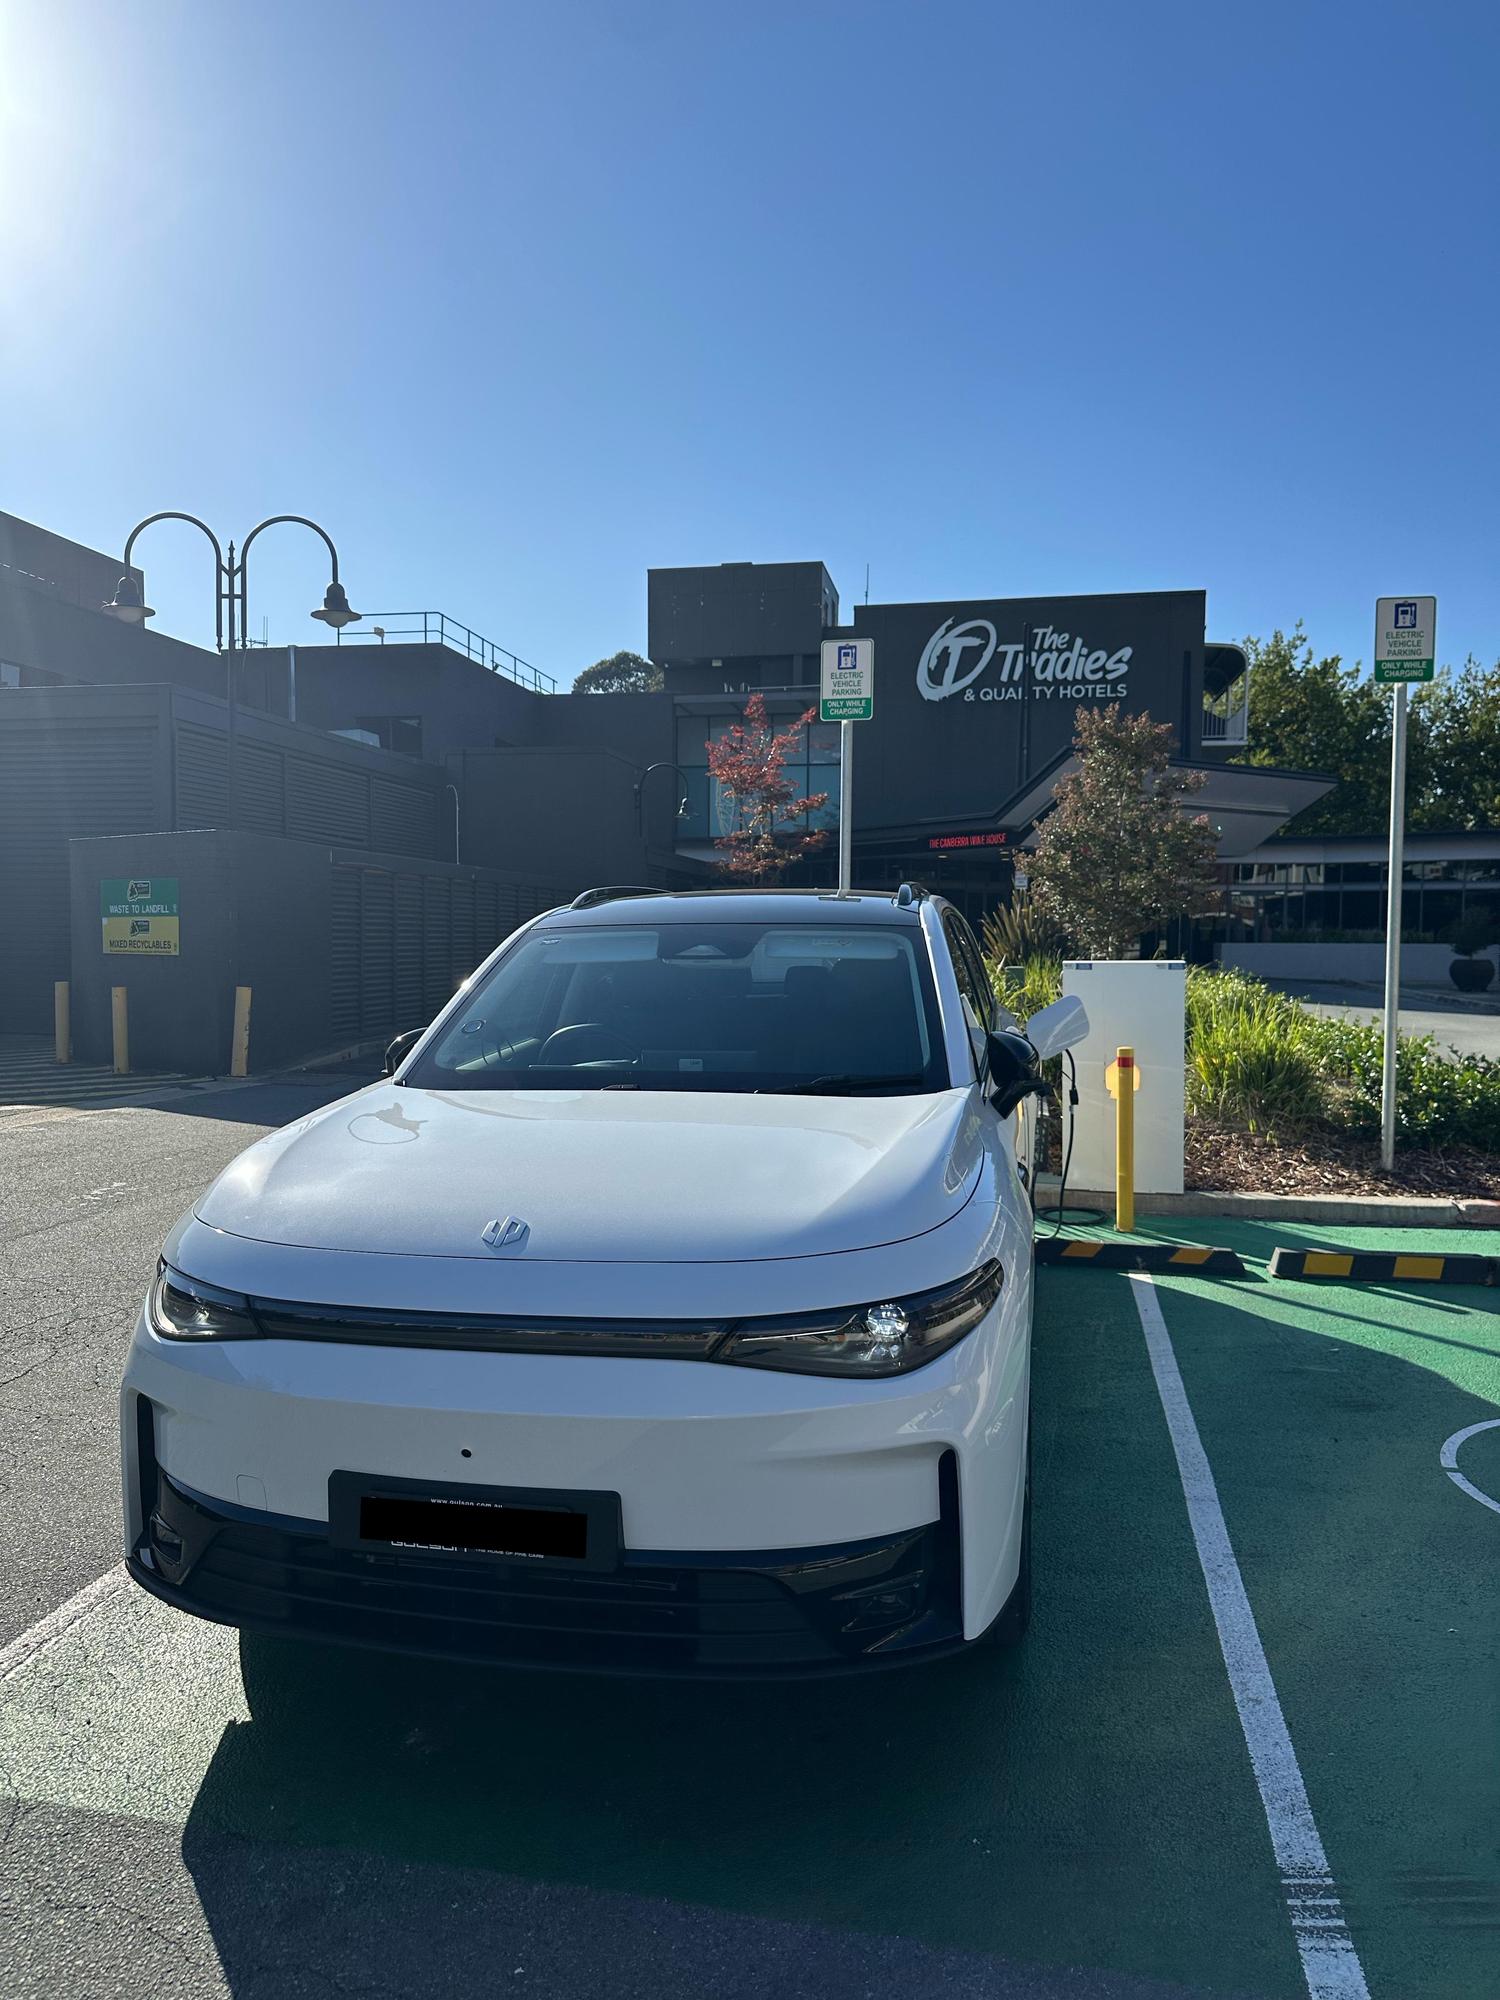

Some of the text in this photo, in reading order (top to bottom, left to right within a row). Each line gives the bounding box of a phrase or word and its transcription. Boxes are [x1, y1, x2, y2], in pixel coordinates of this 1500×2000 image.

[1032, 625, 1070, 650] The
[1385, 631, 1425, 639] ELECTRIC
[1386, 648, 1422, 657] PARKING
[996, 637, 1133, 682] Tradies
[1381, 662, 1401, 670] ONLY
[830, 671, 864, 679] ELECTRIC
[1383, 669, 1424, 678] CHARGING
[832, 680, 862, 688] VEHICLE
[831, 688, 862, 696] PARKING
[963, 683, 1128, 702] & QUALTY HOTELS
[827, 700, 844, 708] ONLY
[829, 707, 864, 715] CHARGING
[929, 839, 940, 849] THE
[940, 836, 969, 849] CANBERRA
[986, 833, 1007, 845] HOUSE
[109, 905, 129, 913] WASTE
[132, 905, 140, 913] TO
[142, 905, 169, 913] LANDFILL
[109, 939, 128, 949] MIXED
[128, 940, 172, 949] RECYCLABLES
